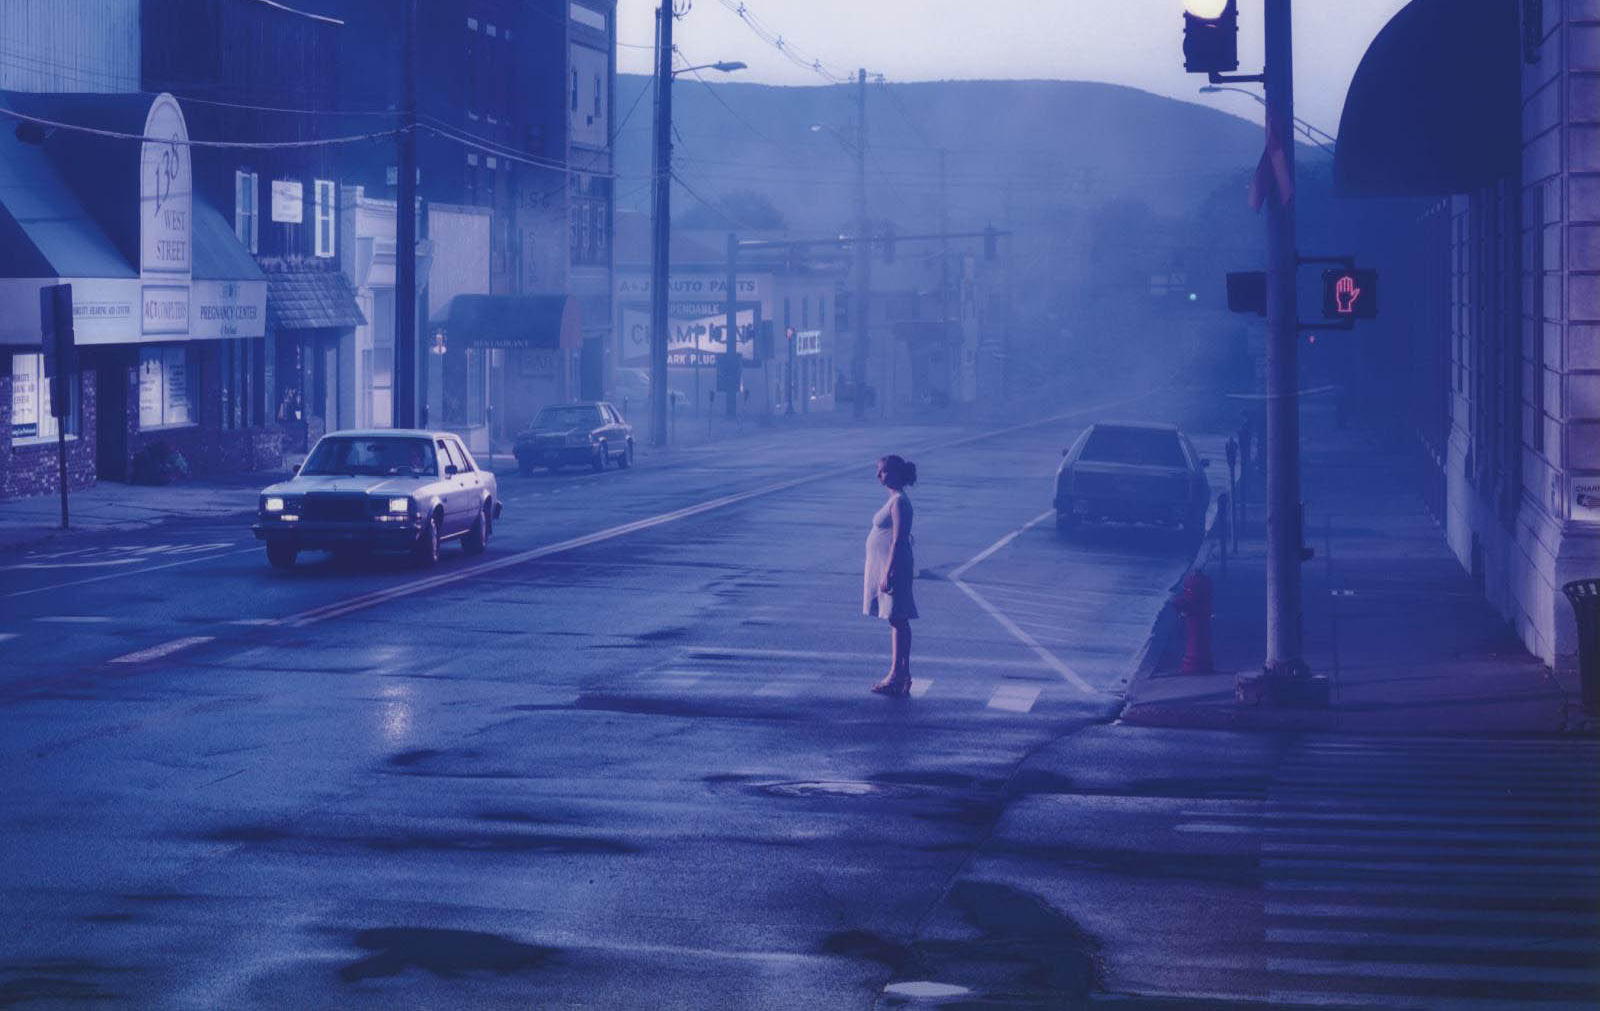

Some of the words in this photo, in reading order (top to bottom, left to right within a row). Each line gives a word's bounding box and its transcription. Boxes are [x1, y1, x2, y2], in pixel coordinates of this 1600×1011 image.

[164, 211, 186, 231] WEST
[156, 240, 186, 261] STREET
[710, 280, 755, 291] PATS
[200, 305, 234, 320] PREGNANCY
[235, 305, 257, 319] CENTER
